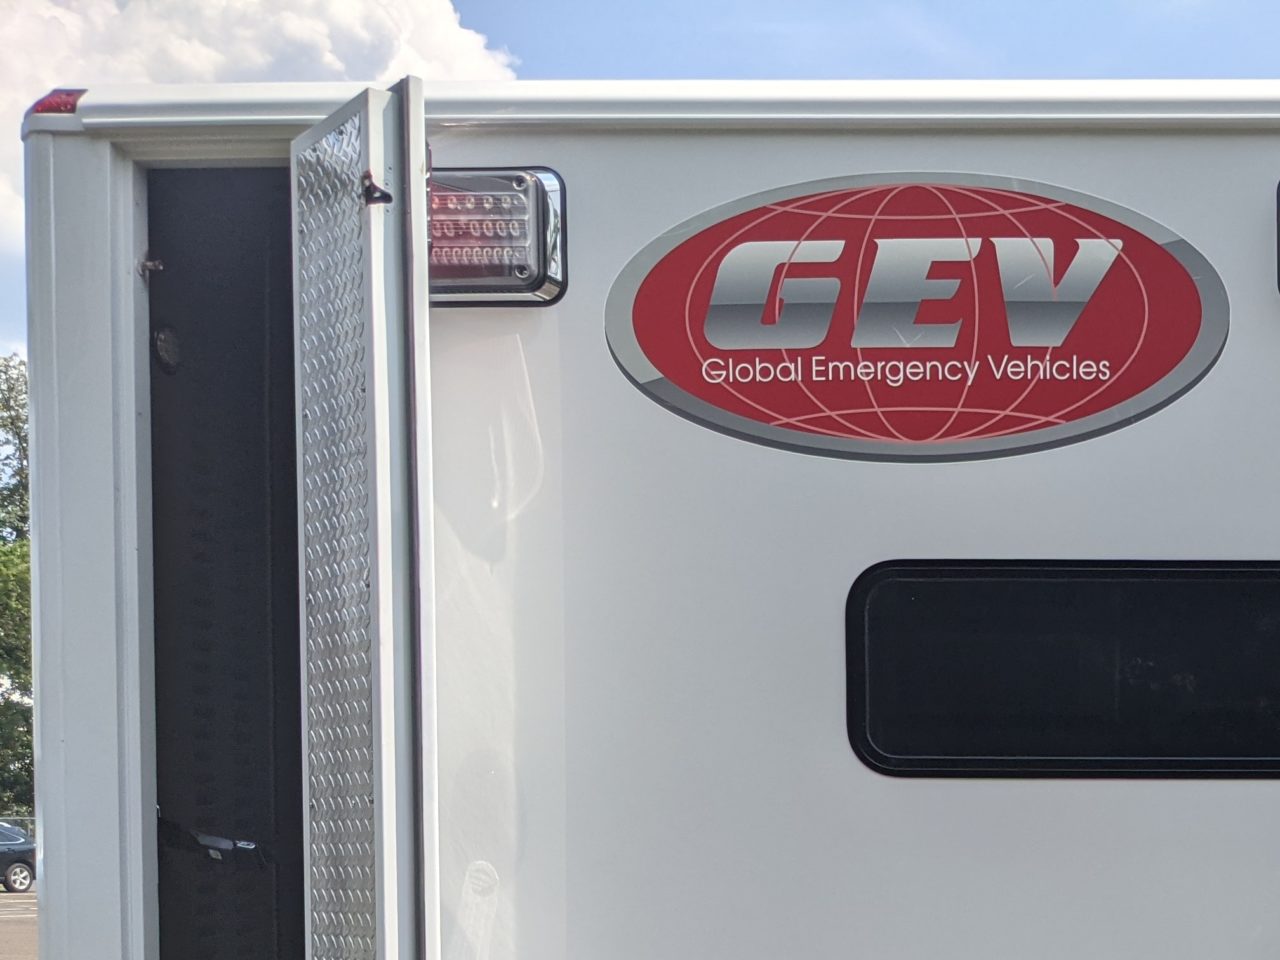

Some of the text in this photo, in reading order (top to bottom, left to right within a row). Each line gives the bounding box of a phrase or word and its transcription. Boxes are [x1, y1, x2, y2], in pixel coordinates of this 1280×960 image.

[704, 238, 1123, 350] GEV
[702, 355, 1110, 386] Global Emergency Vehicles
